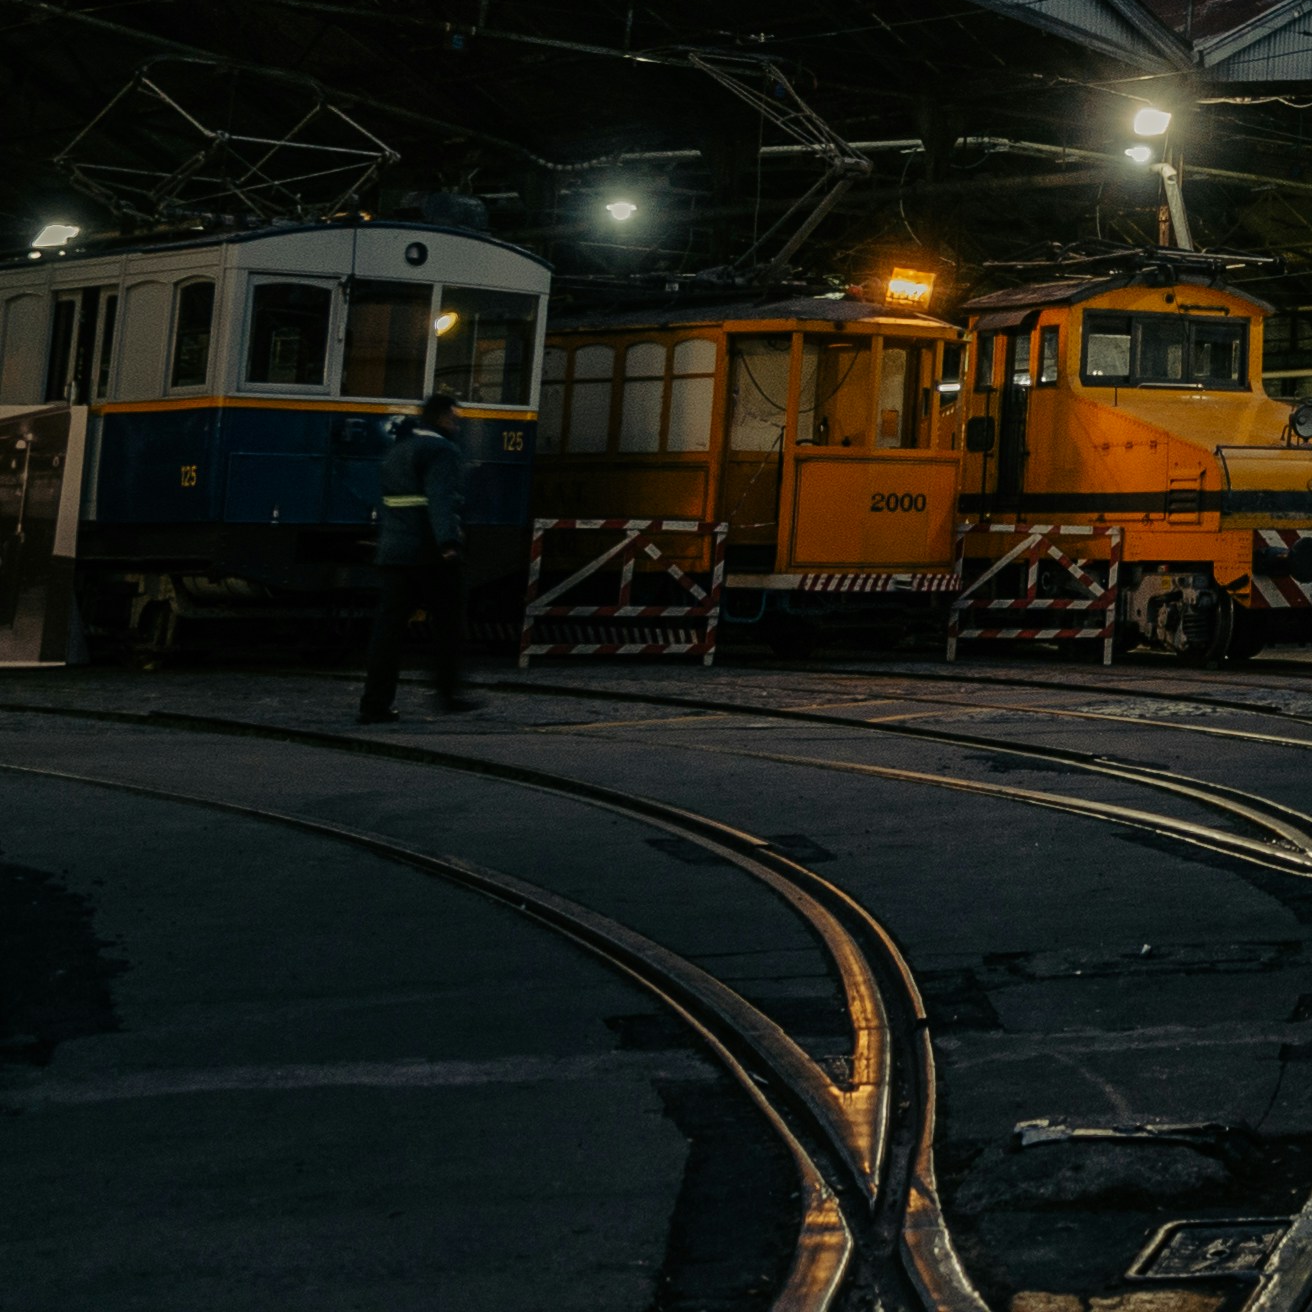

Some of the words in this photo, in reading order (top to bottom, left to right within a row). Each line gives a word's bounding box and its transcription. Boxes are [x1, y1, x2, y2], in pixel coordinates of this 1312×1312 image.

[502, 431, 525, 453] 125
[179, 463, 199, 487] 125
[870, 492, 927, 513] 2000
